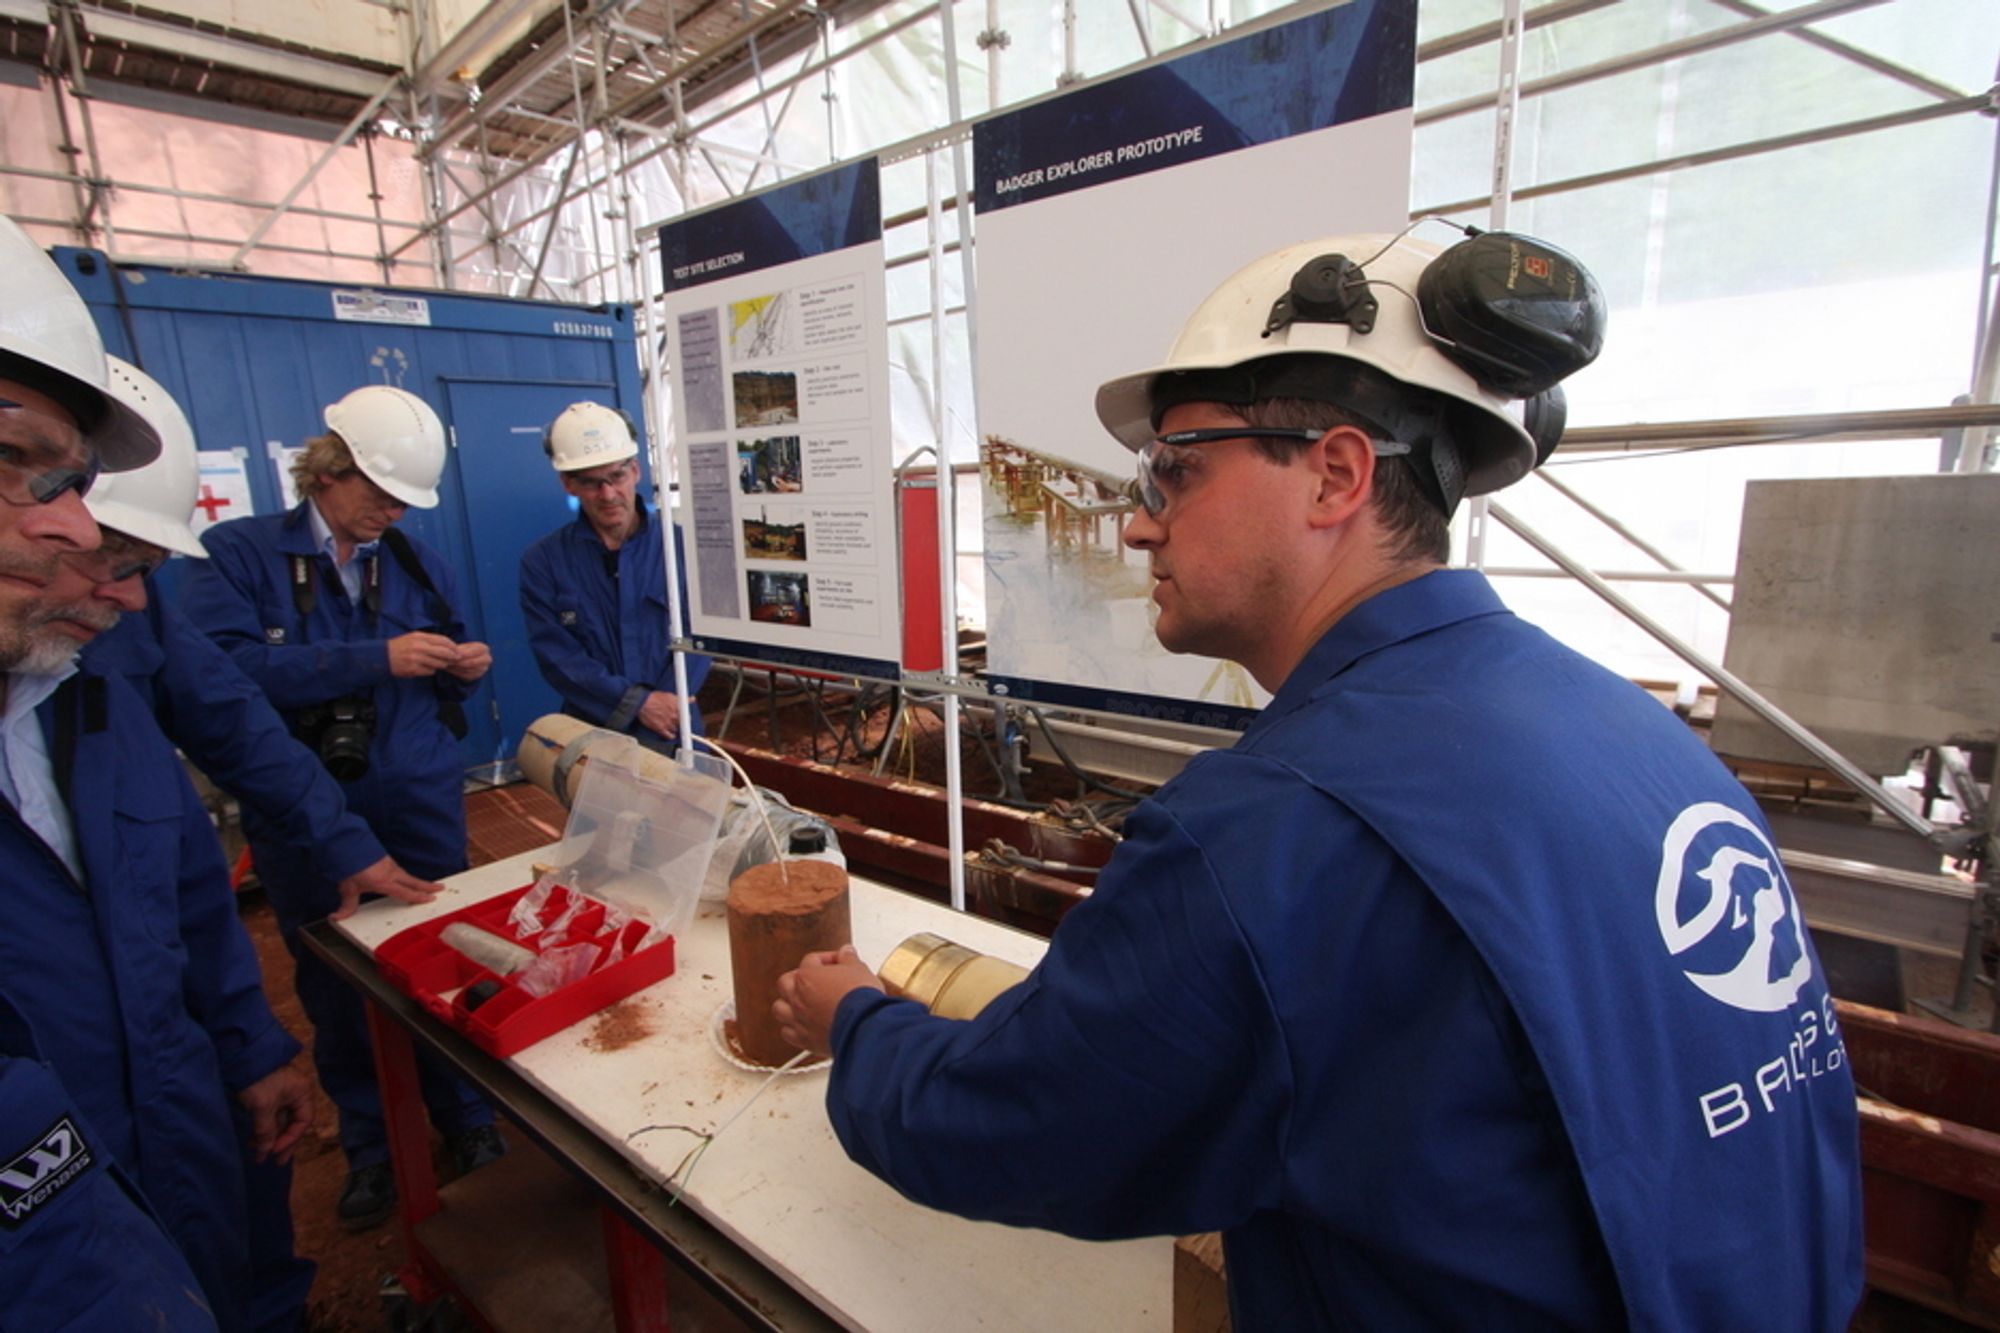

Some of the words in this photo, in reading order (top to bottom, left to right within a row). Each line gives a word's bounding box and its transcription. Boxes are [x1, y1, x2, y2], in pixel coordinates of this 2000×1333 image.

[996, 169, 1044, 194] BADGER
[1047, 150, 1114, 181] EXPLORER
[1117, 126, 1203, 163] PROTOTYPE
[673, 266, 689, 280] TEST
[690, 260, 704, 275] SITE
[705, 251, 745, 270] SELECTION
[1699, 993, 1838, 1138] BADGE
[7, 1153, 91, 1219] Wenaas
